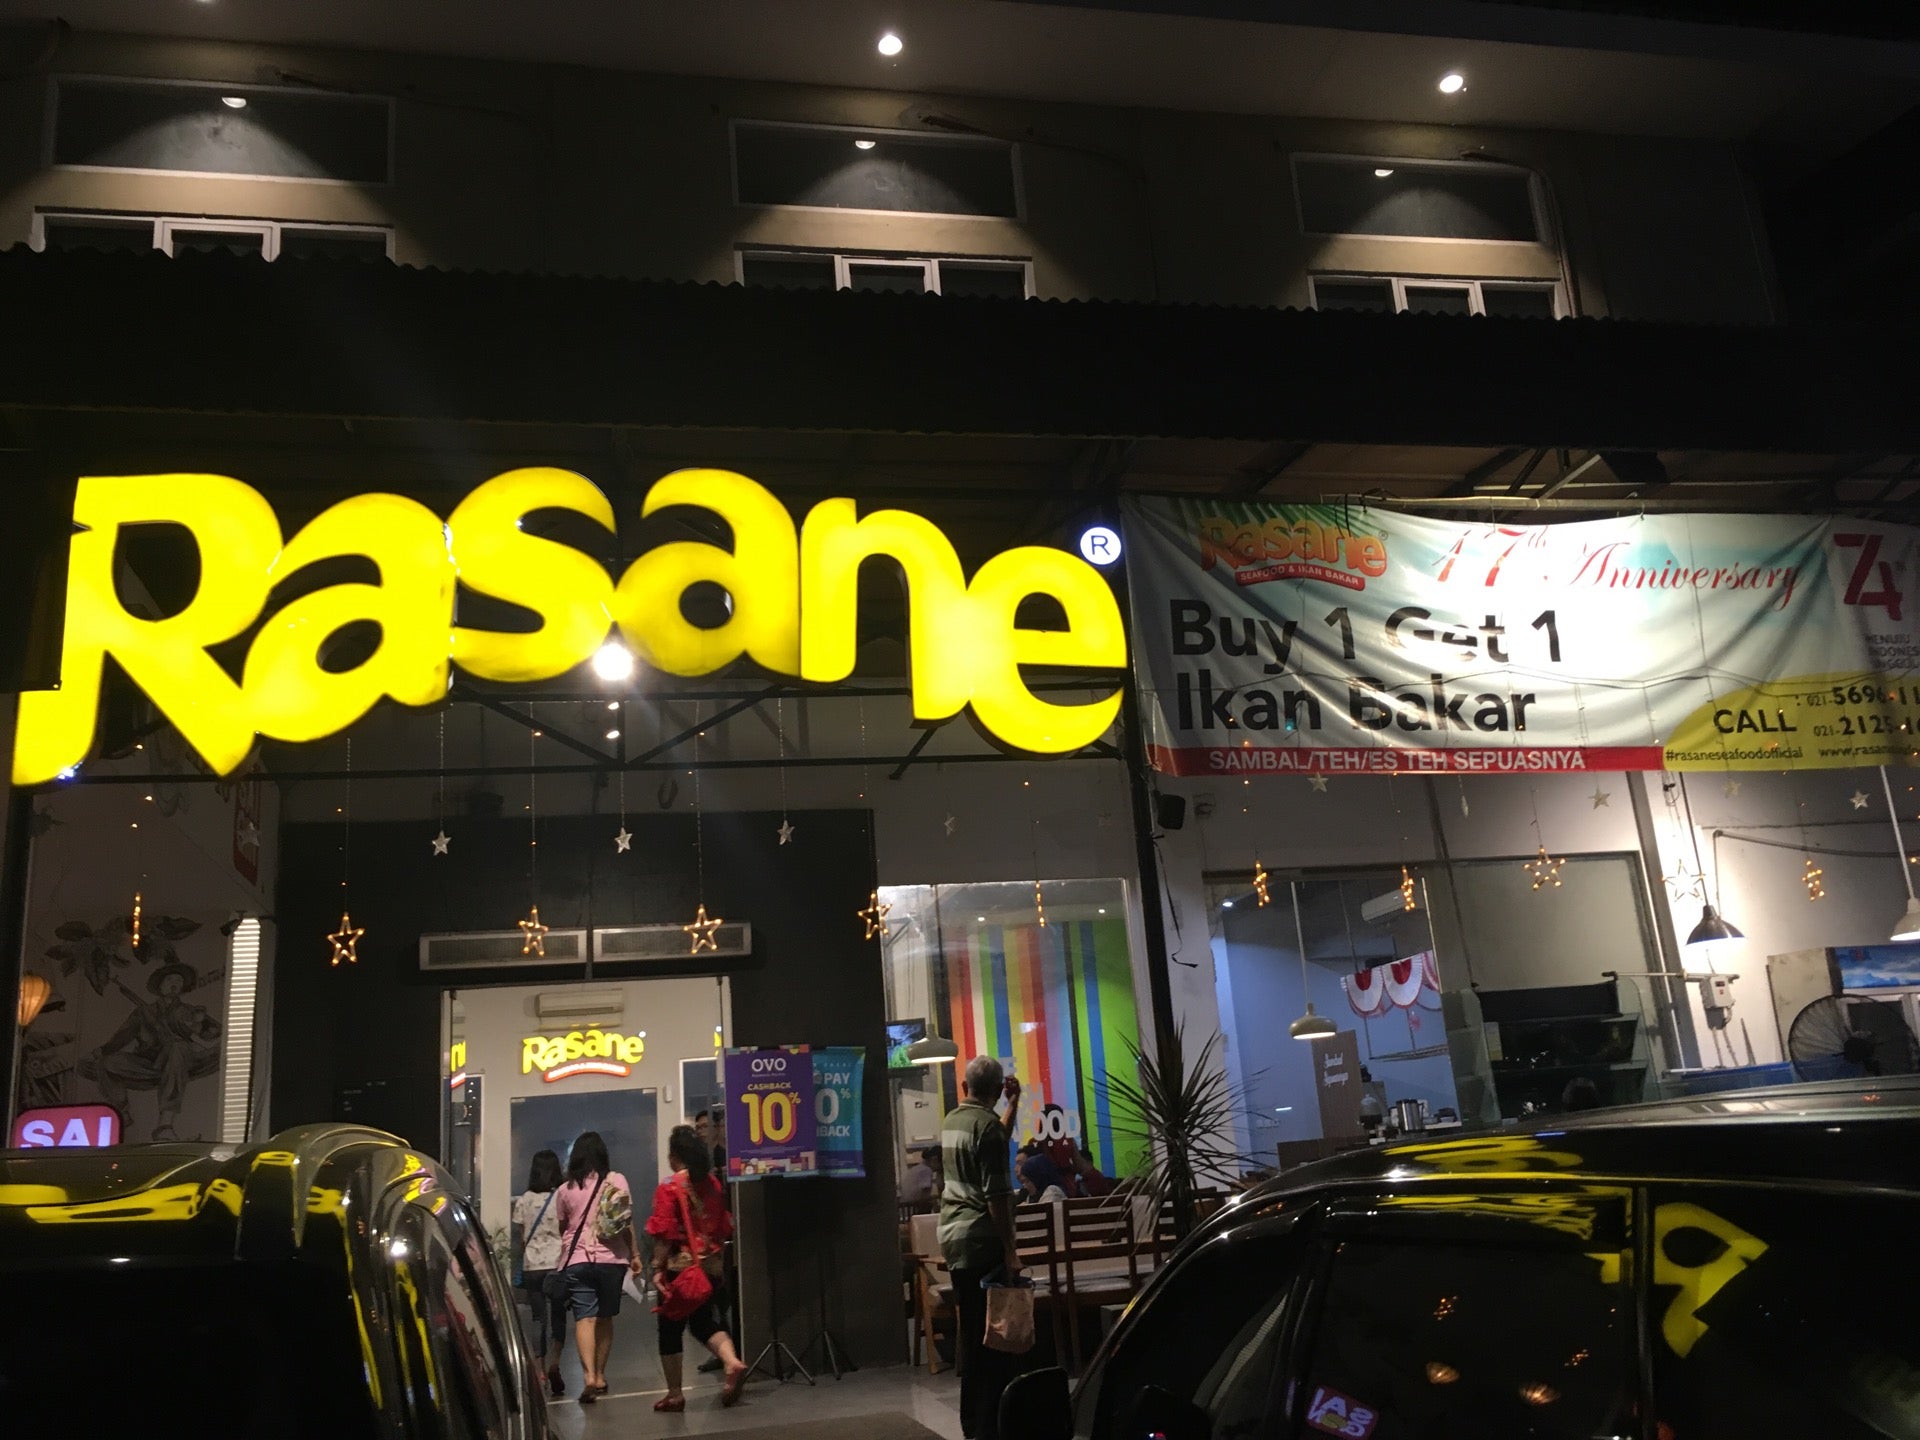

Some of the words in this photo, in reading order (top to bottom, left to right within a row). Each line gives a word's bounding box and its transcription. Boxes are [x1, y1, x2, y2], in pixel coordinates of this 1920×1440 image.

[1201, 517, 1387, 577] Rasane
[1325, 571, 1359, 585] BAKAR
[1568, 540, 1800, 612] Anniversary
[12, 467, 1127, 785] Rasane
[1170, 599, 1298, 675] Buy
[1324, 607, 1356, 660] 1
[1532, 609, 1562, 663] 1
[1177, 669, 1322, 732] Ikan
[1349, 673, 1536, 733] Bakar
[1713, 709, 1797, 734] CALL
[1209, 751, 1398, 771] SAMBAL/TEH/ES
[1407, 751, 1448, 770] TEH
[1454, 750, 1586, 770] SEPUASNYA
[522, 1030, 645, 1074] Rasane
[751, 1057, 787, 1072] OVO
[747, 1082, 792, 1091] CASHBACK
